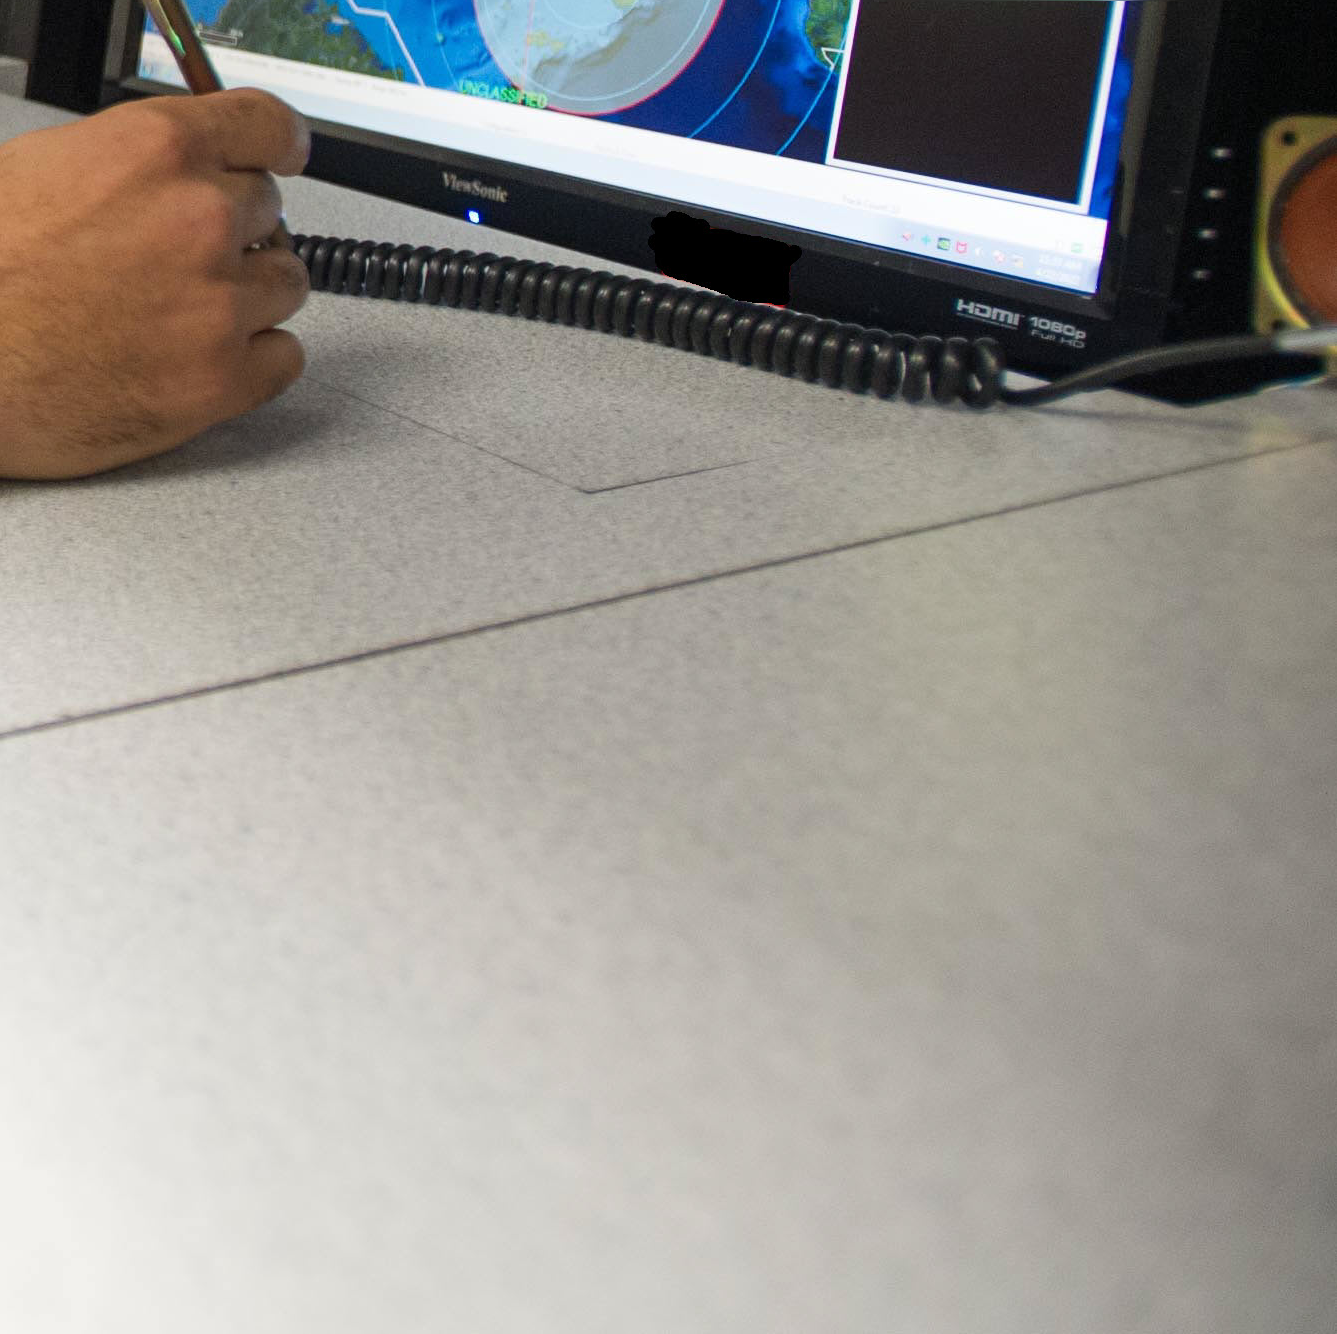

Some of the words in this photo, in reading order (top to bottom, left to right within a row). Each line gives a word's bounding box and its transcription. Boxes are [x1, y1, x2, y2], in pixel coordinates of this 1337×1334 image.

[442, 171, 509, 203] ViewSonic
[957, 299, 1021, 326] HDMI
[1029, 316, 1087, 340] 1080p
[1031, 330, 1056, 341] Full
[1060, 337, 1085, 349] HD
